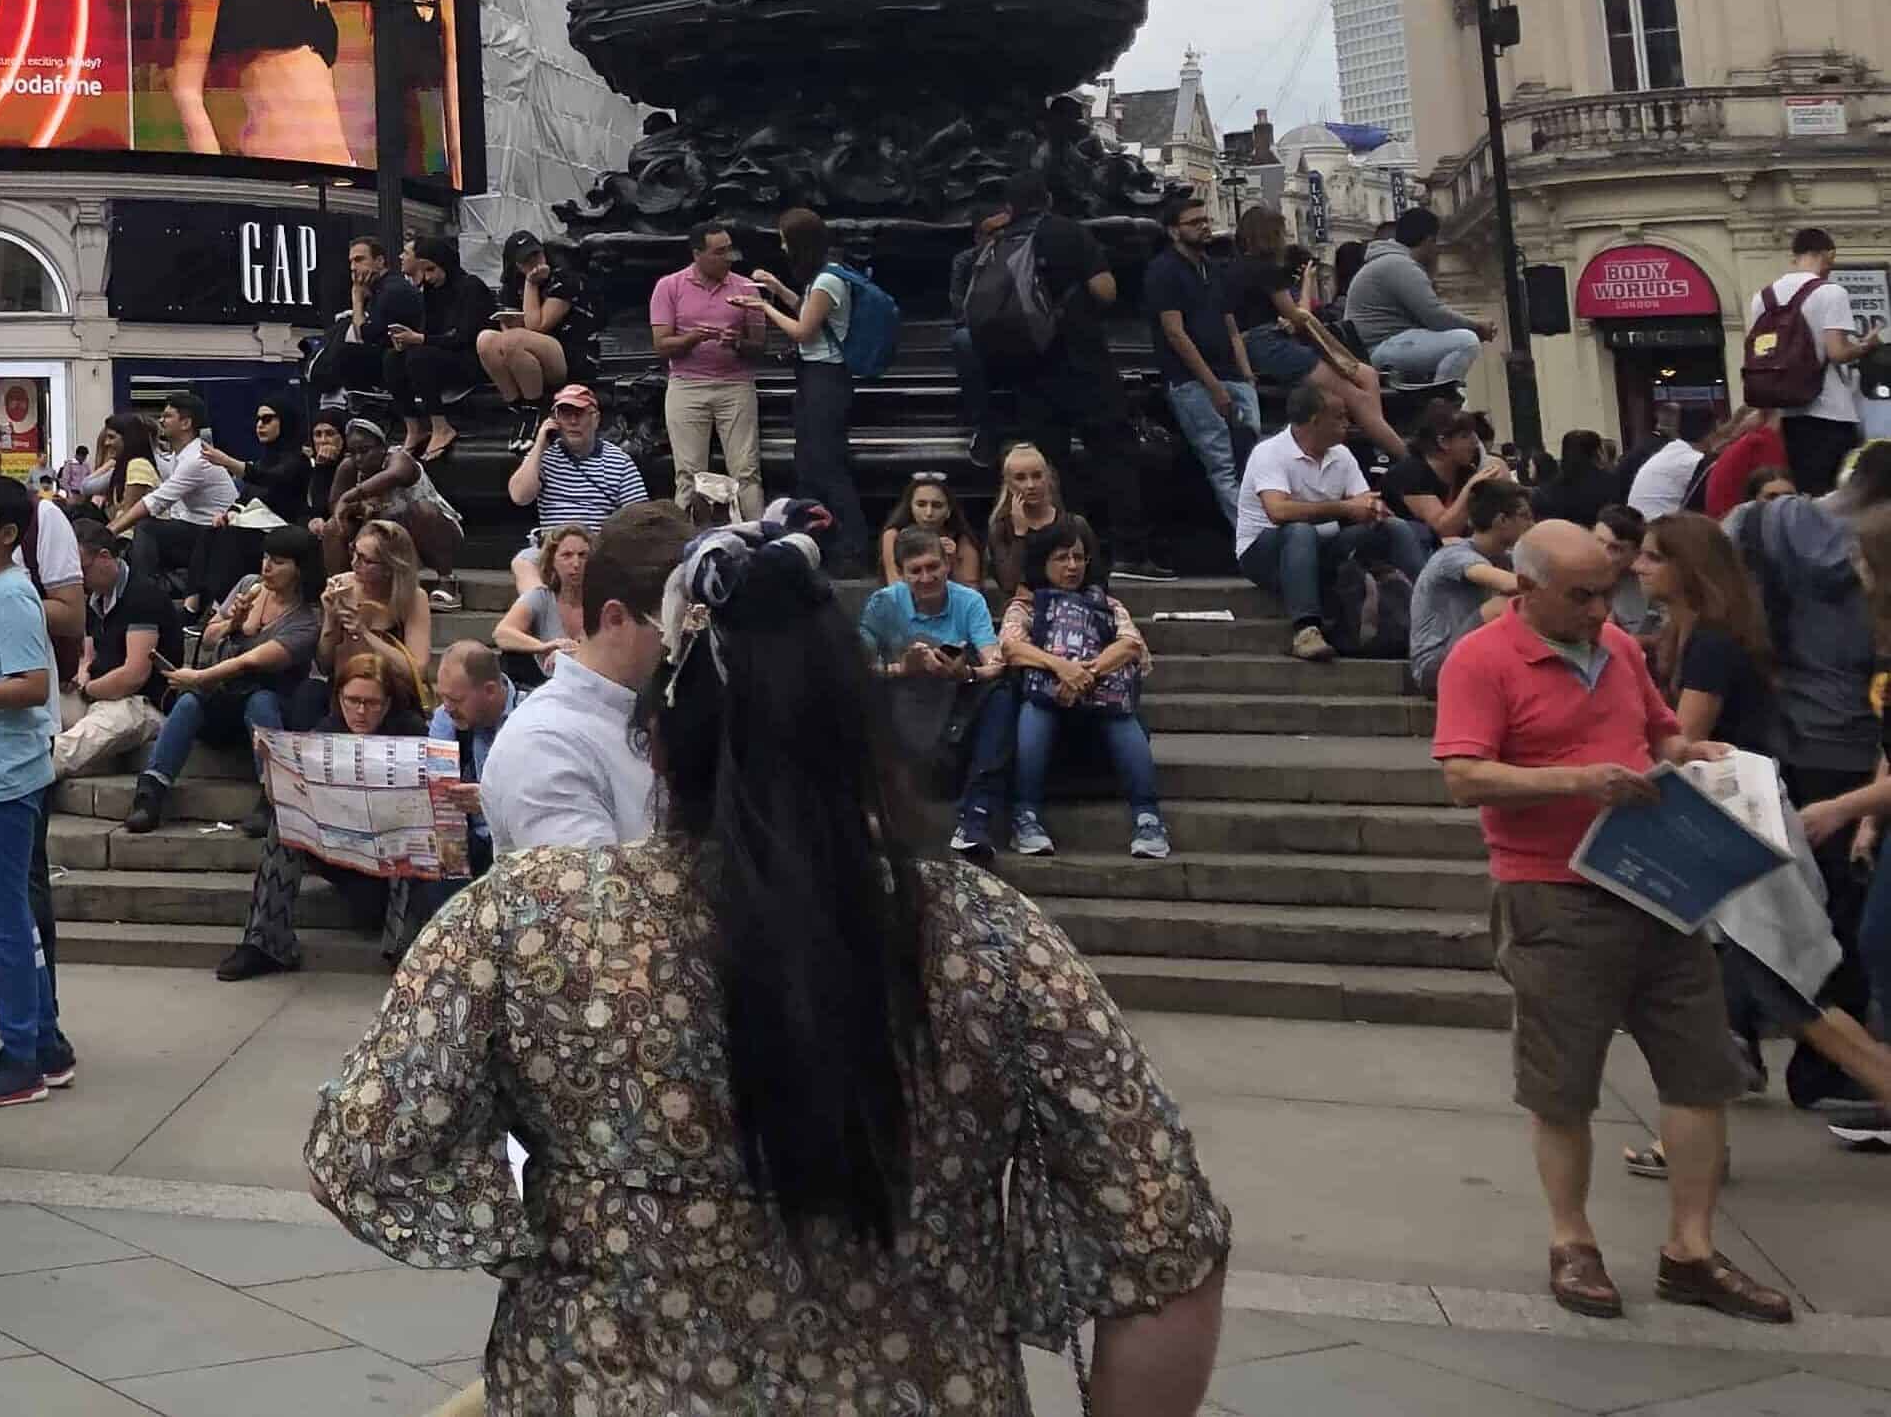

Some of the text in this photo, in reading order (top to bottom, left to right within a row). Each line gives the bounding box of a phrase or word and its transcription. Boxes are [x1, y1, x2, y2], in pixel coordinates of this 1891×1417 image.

[242, 221, 317, 305] GAP
[1603, 261, 1669, 280] BODY
[1592, 280, 1689, 300] WORLDS
